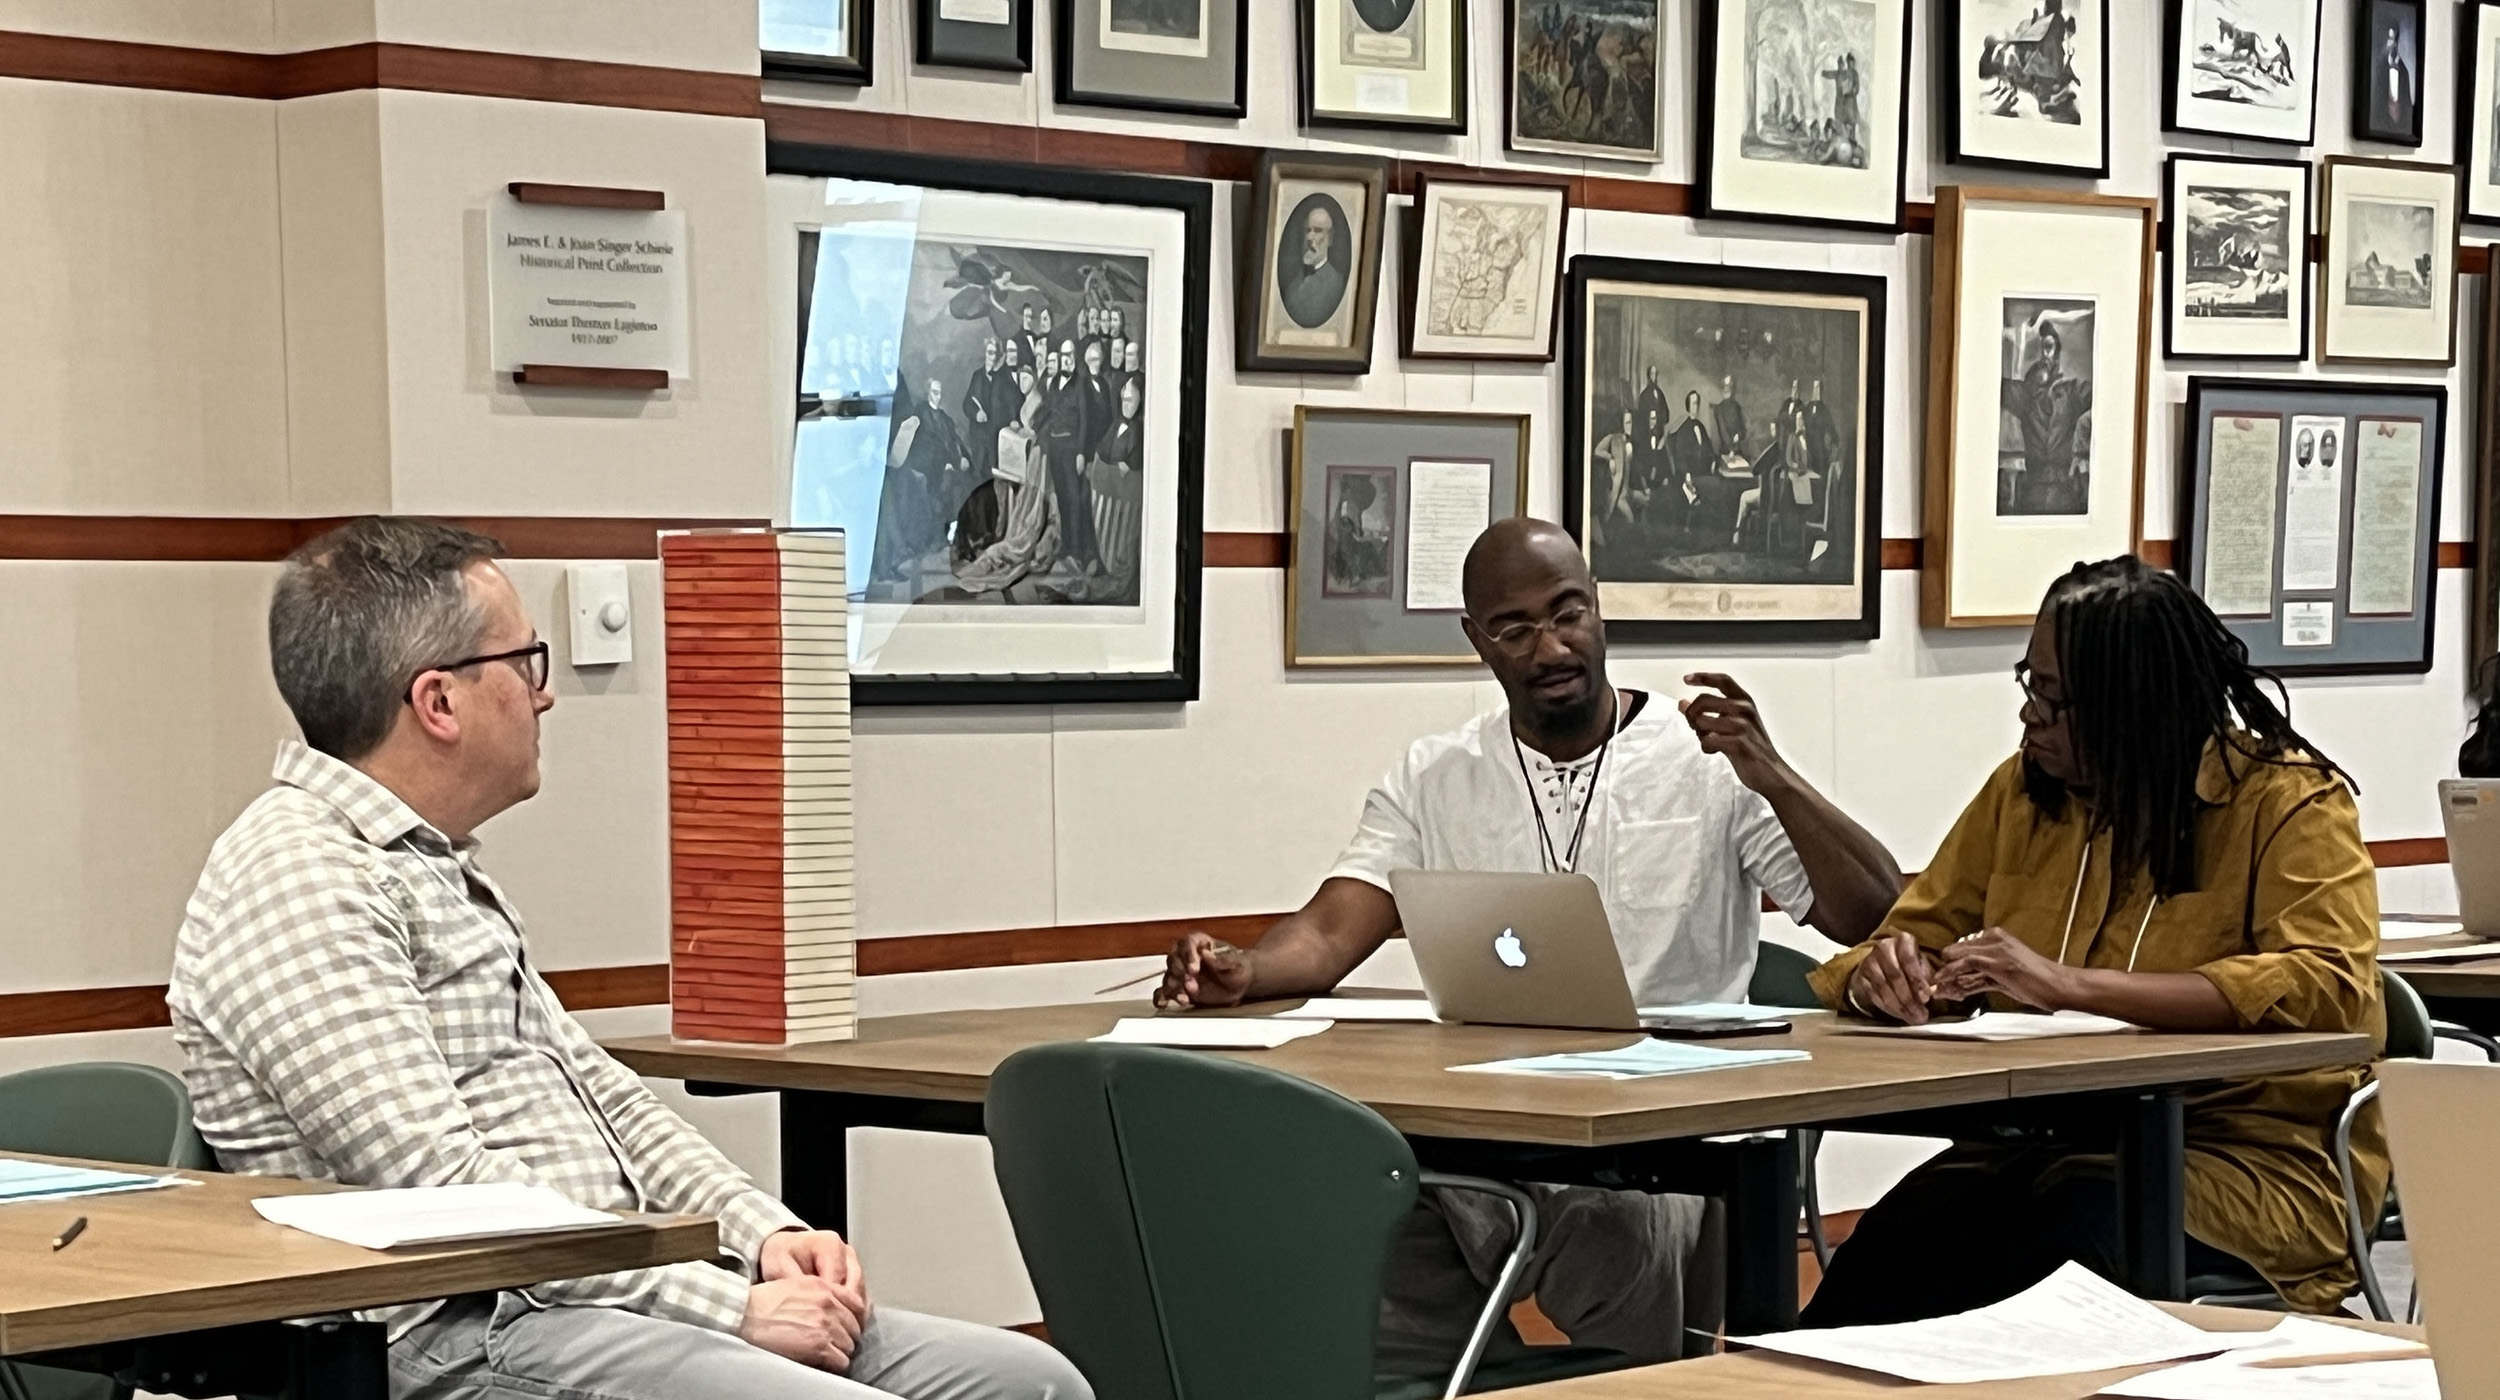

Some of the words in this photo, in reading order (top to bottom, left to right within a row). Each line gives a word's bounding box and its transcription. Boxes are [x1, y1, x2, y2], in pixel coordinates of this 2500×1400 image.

[507, 233, 541, 248] James
[558, 236, 566, 249] &
[520, 253, 574, 270] Historical
[578, 256, 604, 271] Print
[606, 258, 663, 274] Collection
[529, 314, 568, 327] Senator
